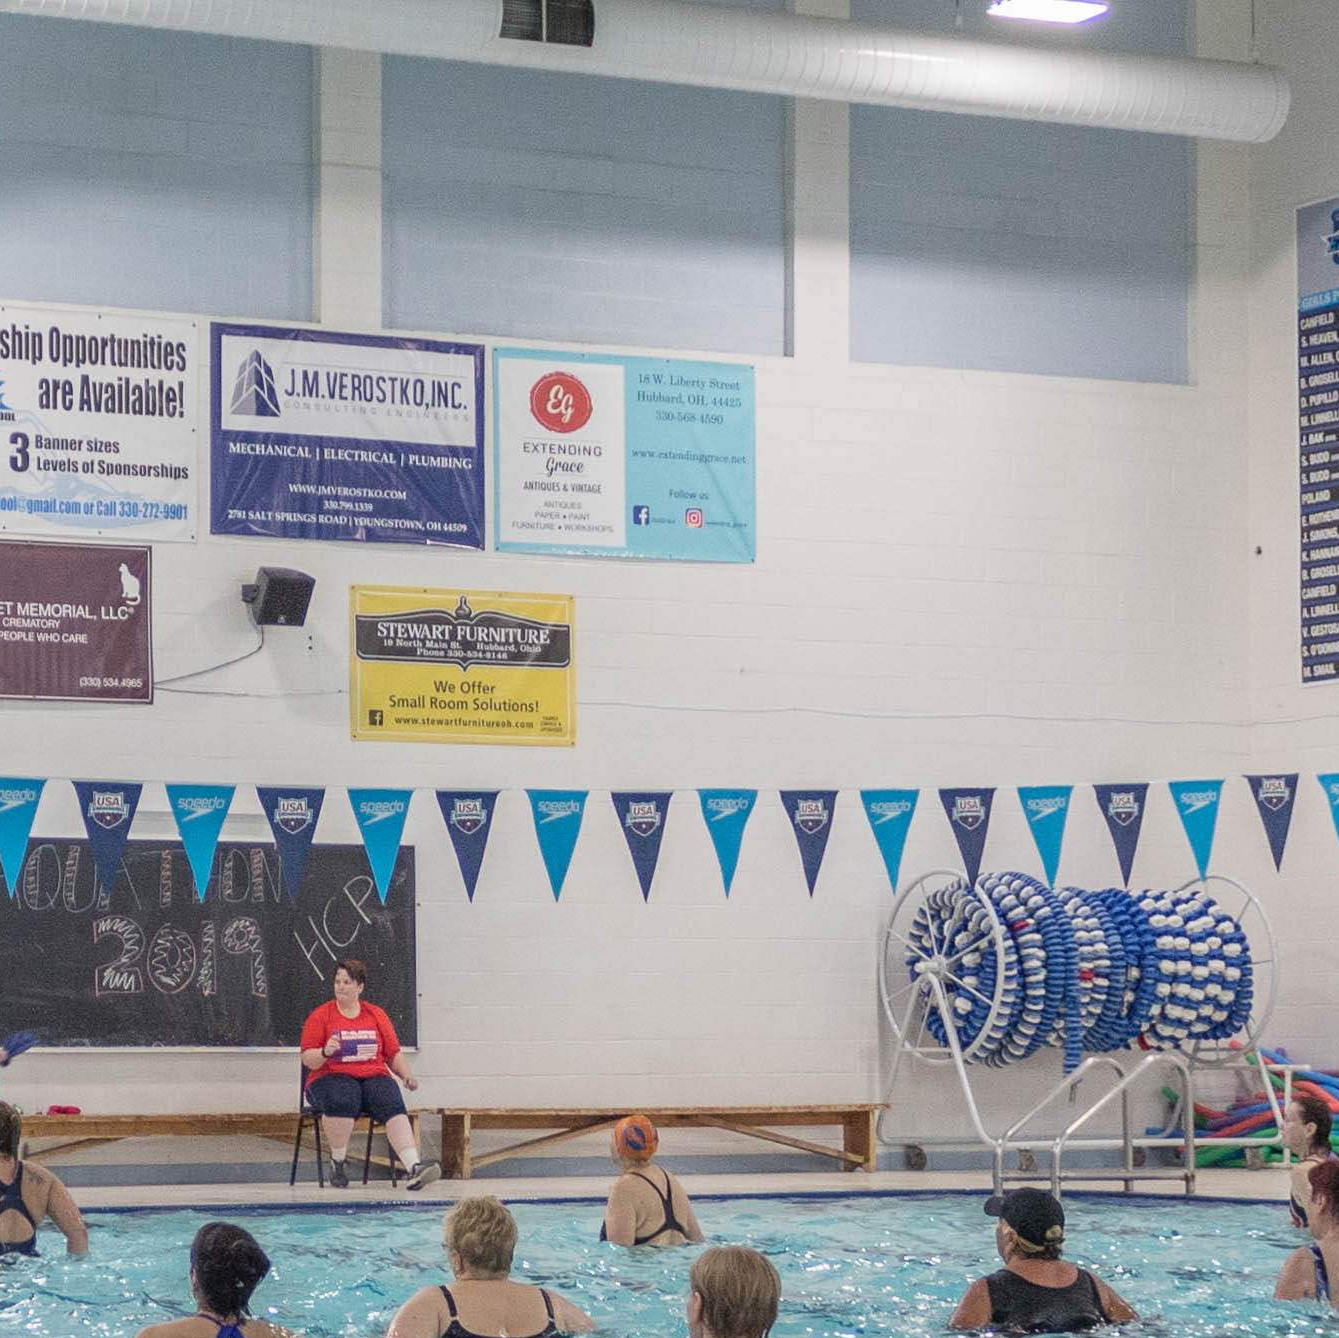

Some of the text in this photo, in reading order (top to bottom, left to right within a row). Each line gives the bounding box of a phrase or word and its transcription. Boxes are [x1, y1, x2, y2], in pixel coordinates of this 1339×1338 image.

[48, 326, 187, 372] Opportunities
[670, 376, 707, 390] Liberty
[709, 378, 740, 391] Street
[38, 374, 185, 418] are Available!
[284, 401, 377, 416] CONSULTING
[34, 435, 121, 454] Banner sizes
[523, 442, 602, 457] EXTENDING
[9, 432, 30, 473] 3
[229, 442, 473, 469] MECHANICAL ELECTRICAL PLUMBING
[36, 457, 189, 480] Levels of Sponsorships
[546, 457, 584, 477] Grace
[288, 483, 407, 500] WWW.JMVEROSTKO.COM
[523, 481, 602, 494] ANTIQUES & VINTAGE
[669, 489, 697, 499] Follow
[83, 501, 95, 516] or
[96, 499, 117, 517] Call
[248, 510, 273, 521] SALT
[275, 512, 317, 523] SPRINGS
[318, 514, 347, 525] ROAD
[353, 517, 425, 531] YOUNGSTOWN,
[427, 521, 442, 531] OH
[17, 602, 97, 620] MEMORIAL,
[2, 617, 60, 628] CREMATORY
[36, 633, 60, 643] WHO
[62, 633, 88, 644] CARE
[377, 621, 550, 645] STEWART FURNITURE
[395, 638, 423, 648] North
[425, 640, 448, 649] Main
[476, 642, 517, 653] Hubbard,
[519, 644, 542, 653] Ohio
[416, 647, 445, 657] Phone
[434, 679, 496, 695] We Offer
[389, 694, 539, 713] Small Room Solutions!
[394, 714, 534, 729] www.stewartfurnitureoh.com
[96, 796, 120, 807] USA
[178, 796, 225, 810] speedo
[281, 802, 304, 812] USA
[360, 800, 404, 814] speedo
[458, 803, 479, 813] USA
[538, 800, 580, 812] speedo
[707, 797, 749, 810] speedo
[801, 803, 821, 813] USA
[960, 799, 979, 809] USA
[1113, 795, 1132, 806] USA
[633, 806, 654, 816] USA
[293, 875, 375, 981] HCP
[93, 915, 267, 997] 2019
